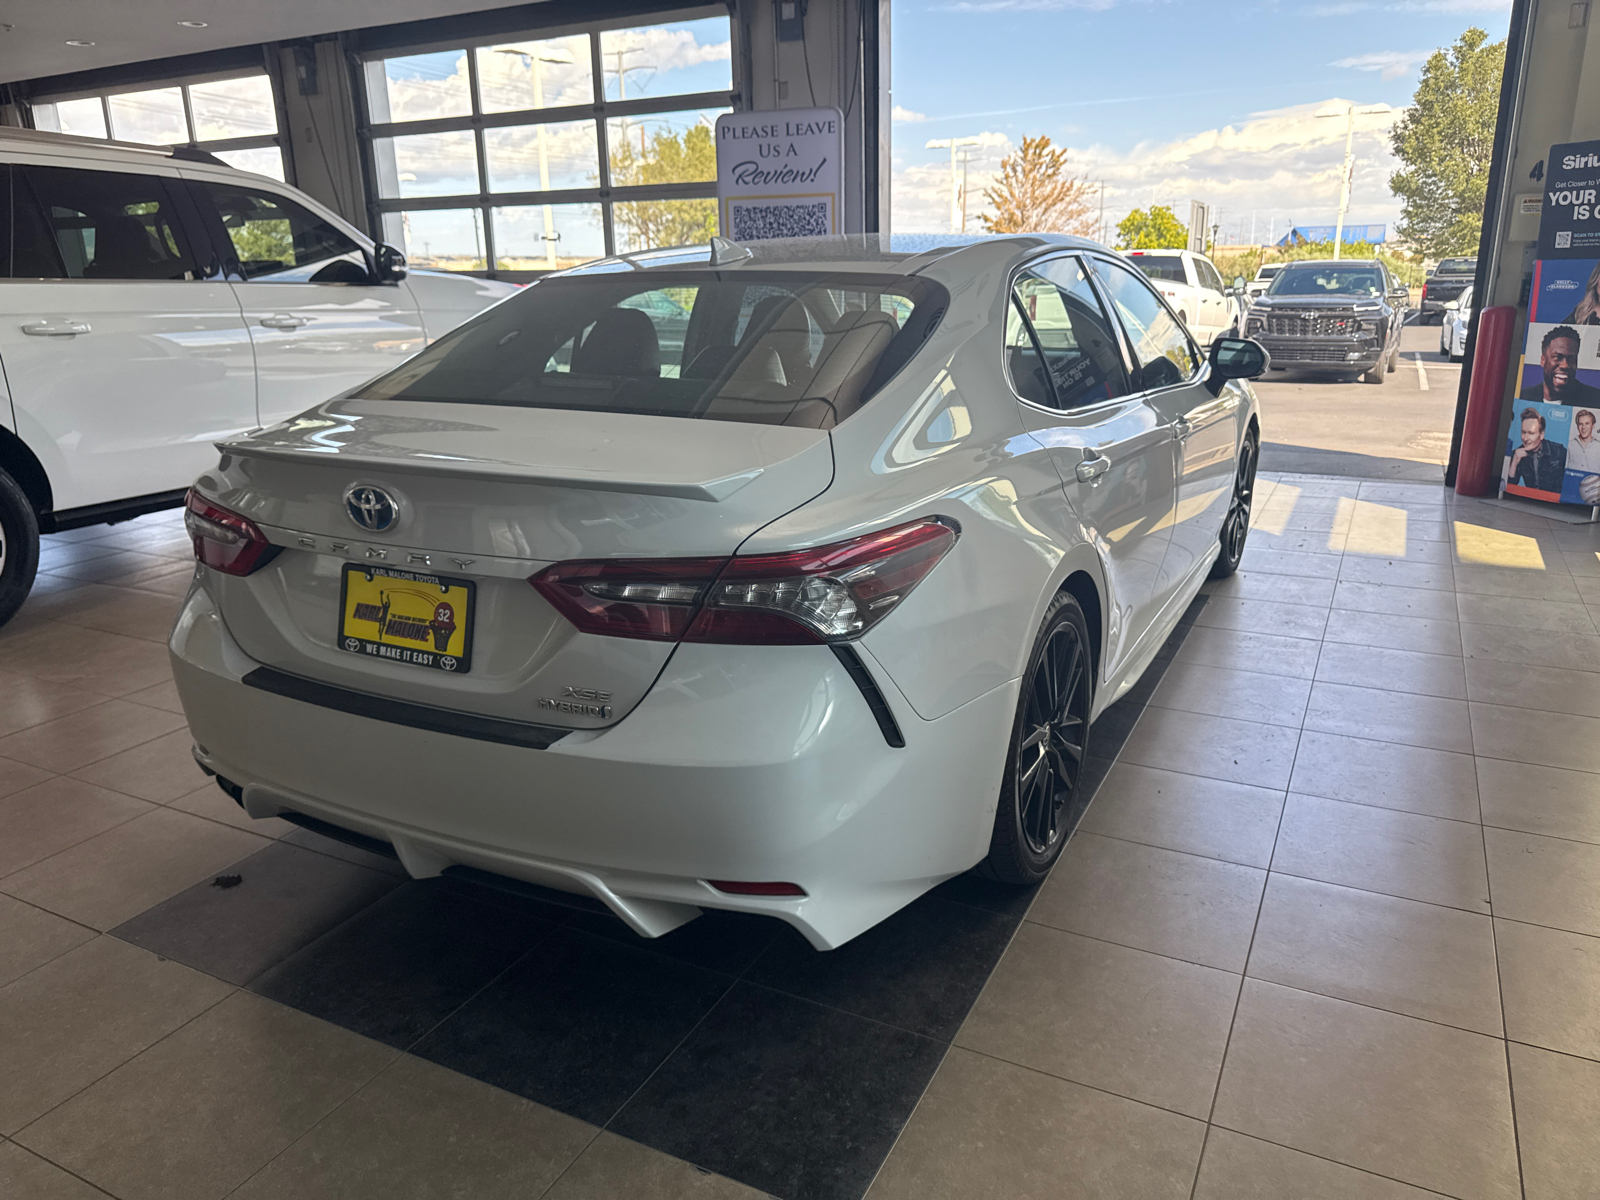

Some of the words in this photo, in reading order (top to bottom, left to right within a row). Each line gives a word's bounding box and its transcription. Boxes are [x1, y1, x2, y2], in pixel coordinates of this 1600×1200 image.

[721, 124, 779, 140] PLEASE
[785, 120, 836, 137] LEAVE
[786, 142, 798, 157] A
[731, 157, 828, 186] Review!
[1529, 160, 1544, 183] 4
[1548, 189, 1596, 206] YOUR
[1573, 204, 1590, 220] IS
[298, 536, 476, 570] CAMRY
[371, 567, 388, 576] KARL
[388, 570, 414, 580] MALONE
[415, 573, 440, 584] TOYOTA
[353, 602, 382, 622] KARL
[438, 608, 450, 623] 32
[385, 619, 430, 643] MALONE
[366, 643, 378, 654] WE
[380, 646, 401, 659] MAKE
[403, 650, 411, 661] IT
[413, 652, 434, 665] EASY
[562, 685, 614, 702] XSE
[538, 697, 601, 717] HYBRID
